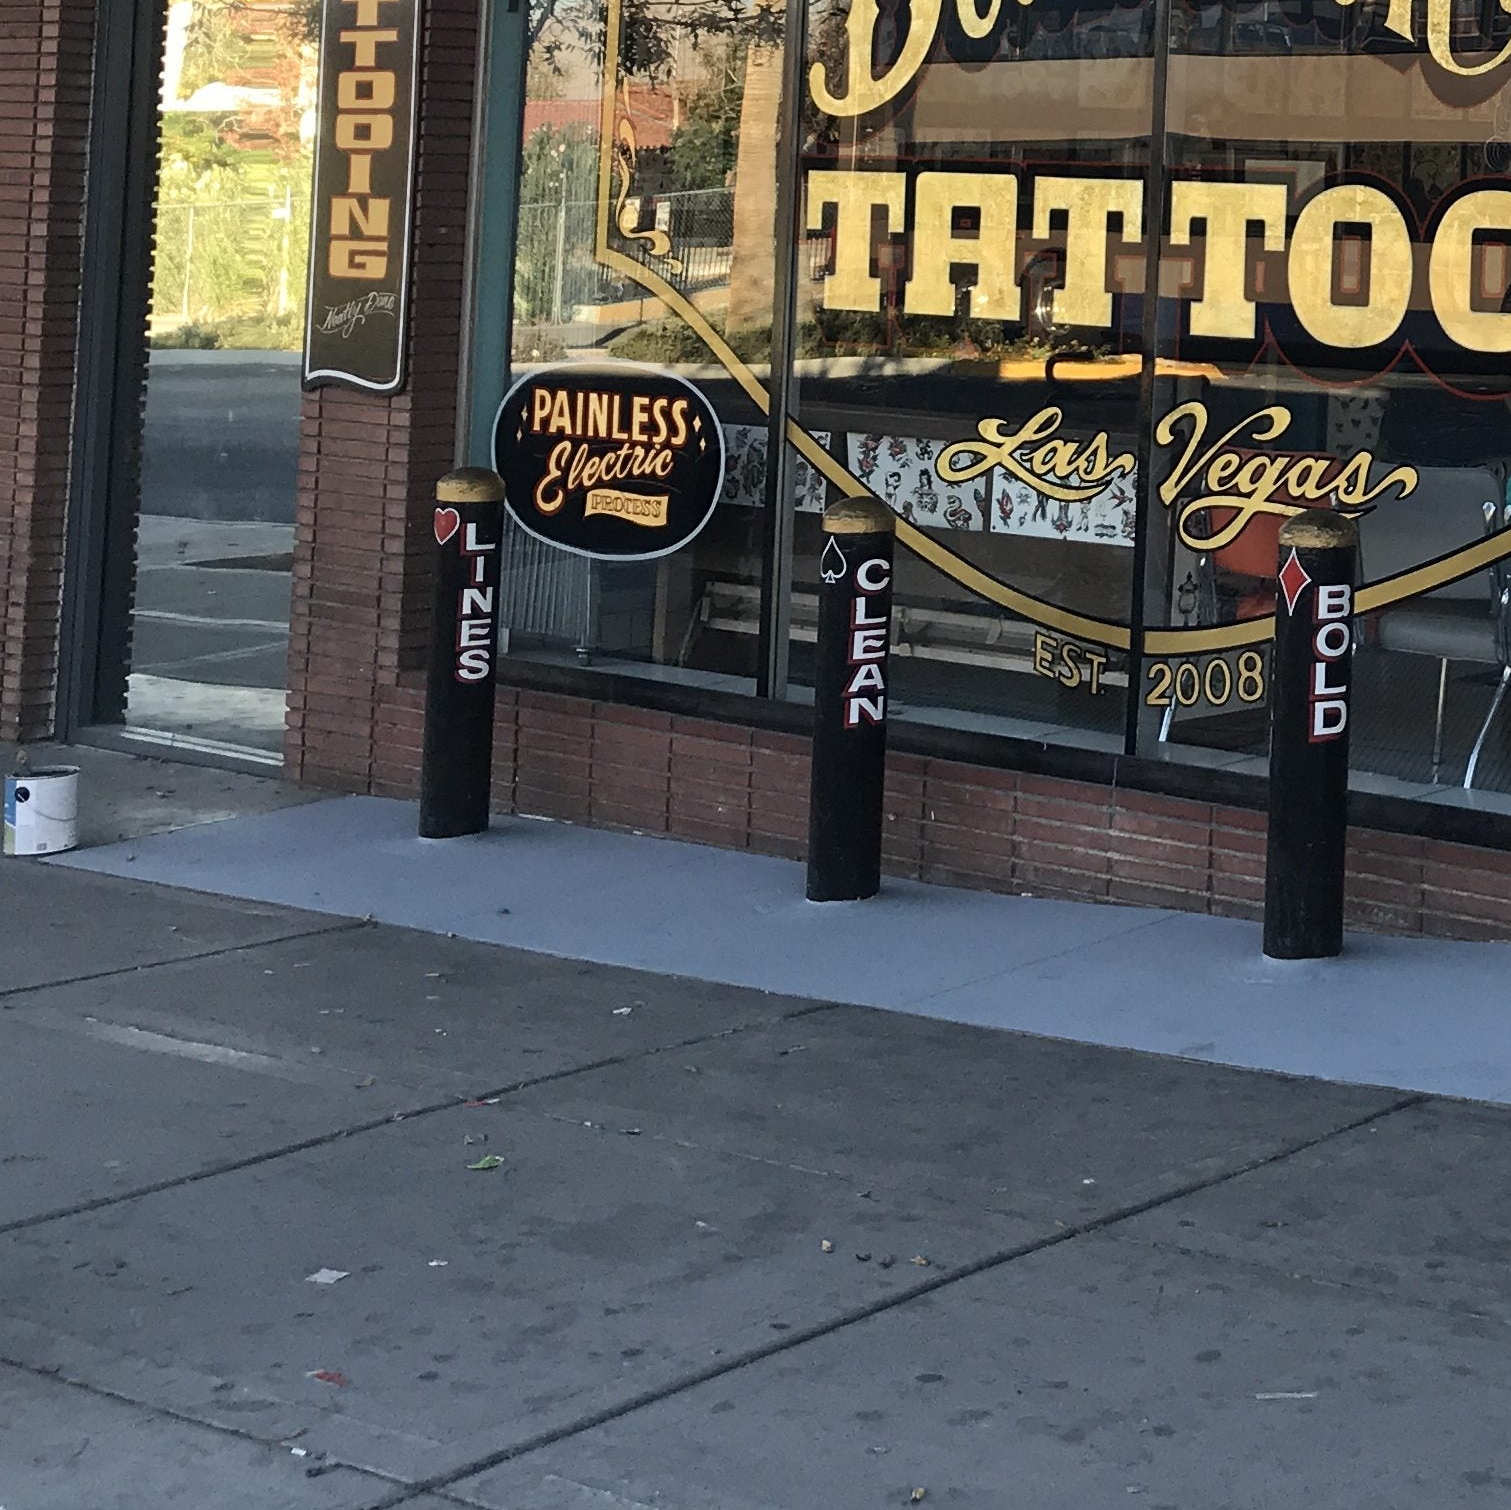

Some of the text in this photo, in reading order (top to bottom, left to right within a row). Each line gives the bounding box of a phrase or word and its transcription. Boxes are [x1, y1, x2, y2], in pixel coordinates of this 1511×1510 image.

[532, 386, 689, 447] PAINLESS
[534, 440, 675, 515] Electric
[590, 492, 663, 519] PROCESS
[936, 401, 1420, 550] Las Vegas
[455, 522, 497, 683] LINES
[843, 558, 891, 730] CLEAN
[1032, 632, 1266, 707] EST. 2008
[1309, 583, 1352, 743] BOLD
